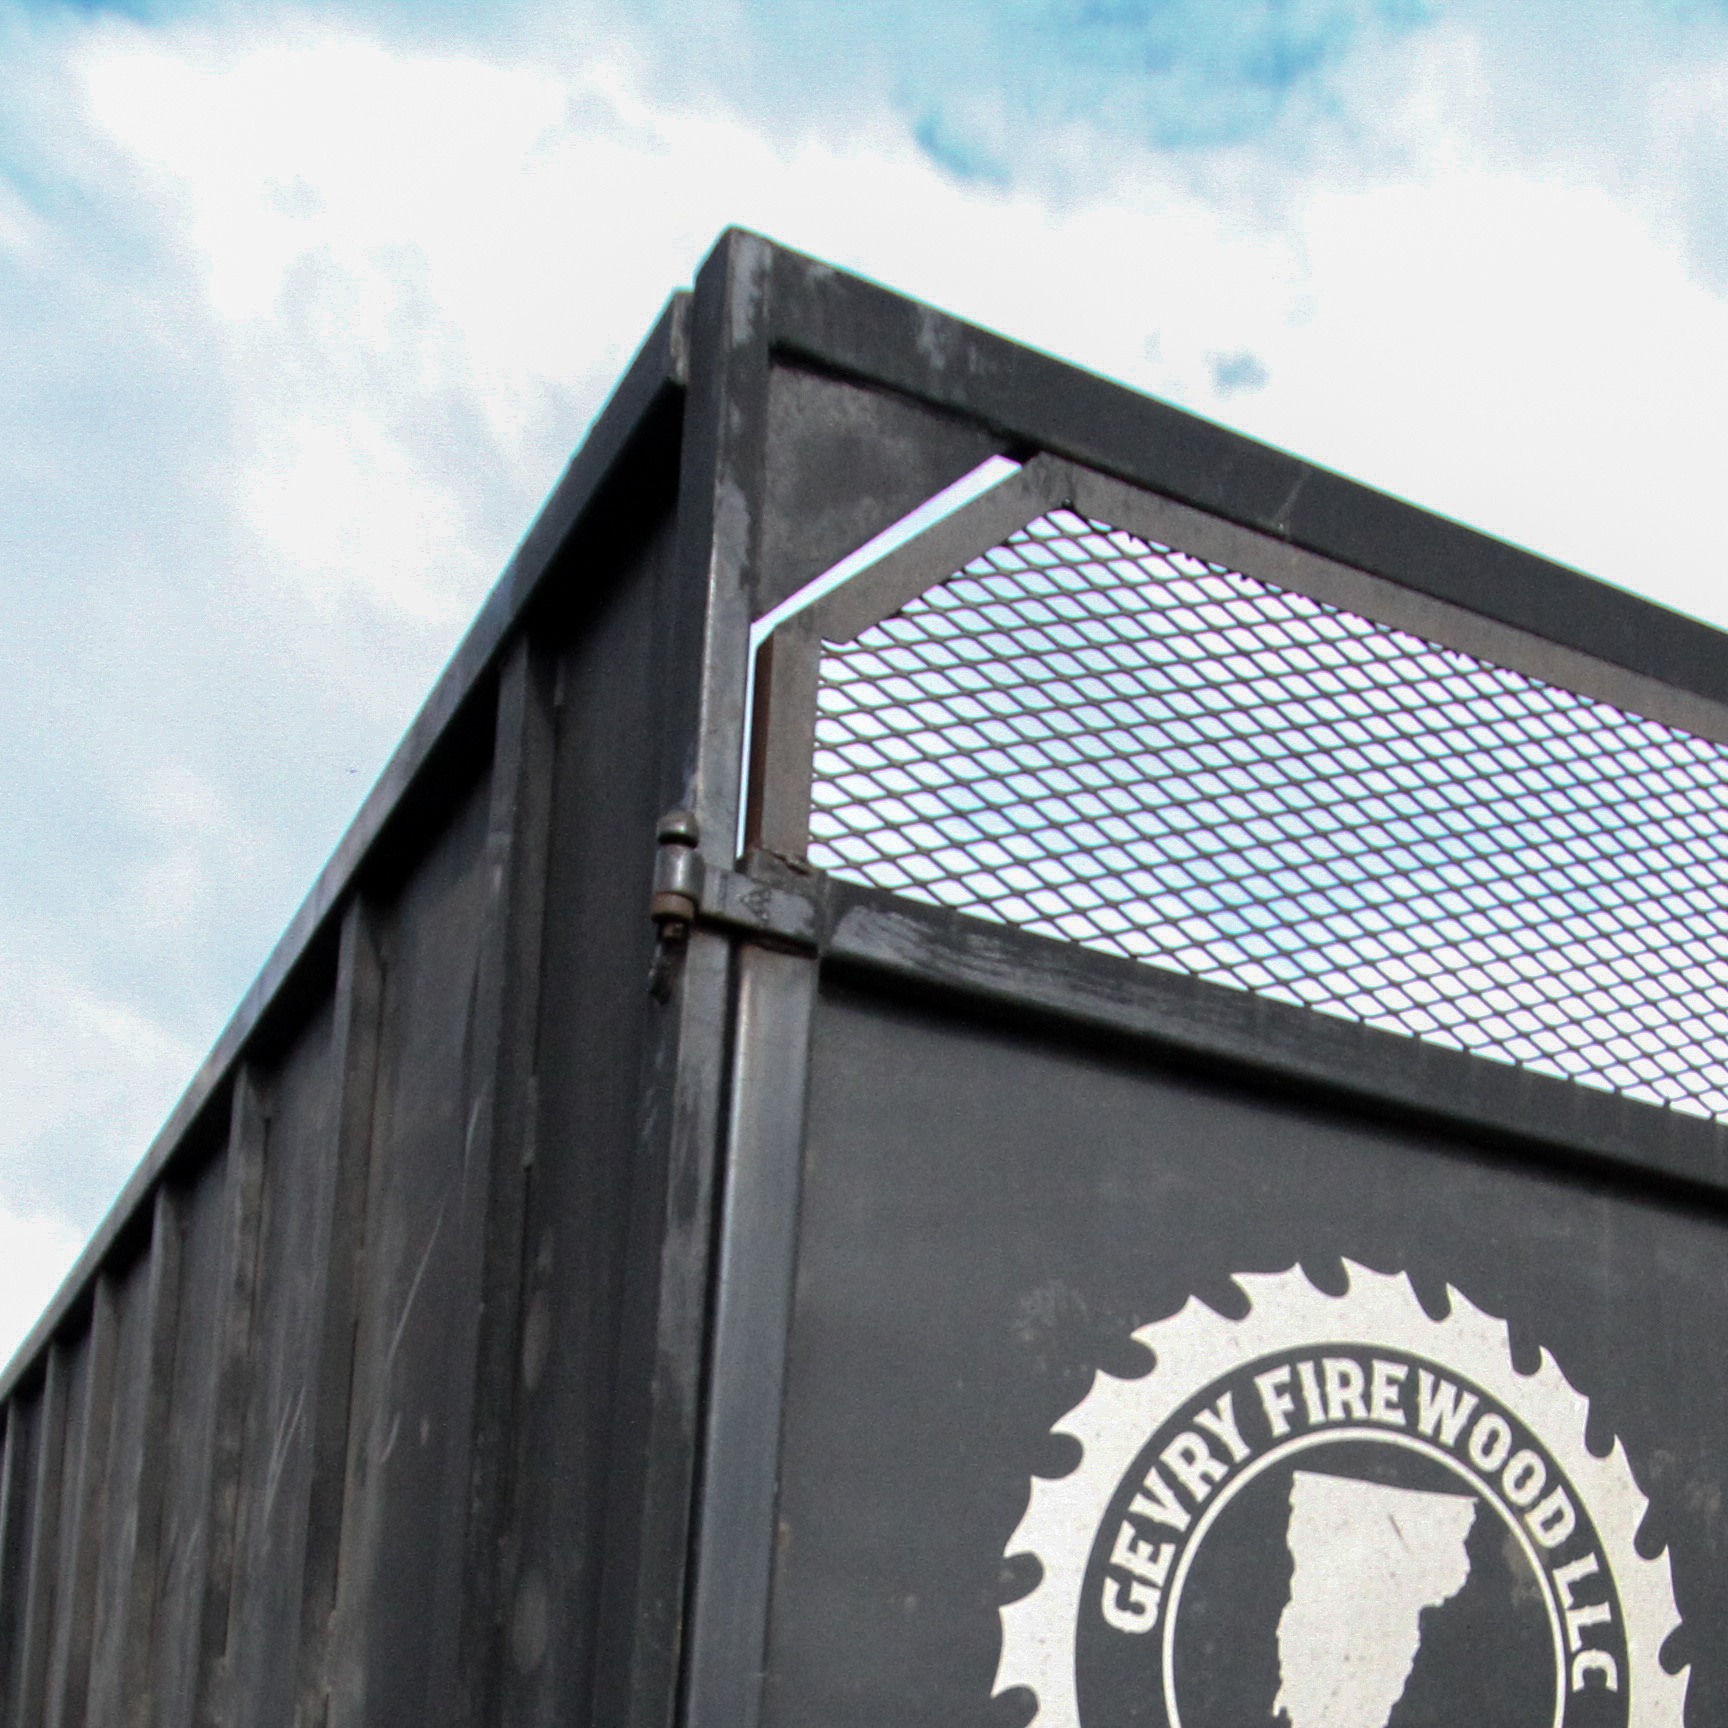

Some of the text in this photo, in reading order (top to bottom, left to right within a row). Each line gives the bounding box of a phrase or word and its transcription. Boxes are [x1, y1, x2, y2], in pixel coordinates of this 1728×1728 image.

[1100, 1356, 1618, 1694] GEVRY FIREWOOD LLC
